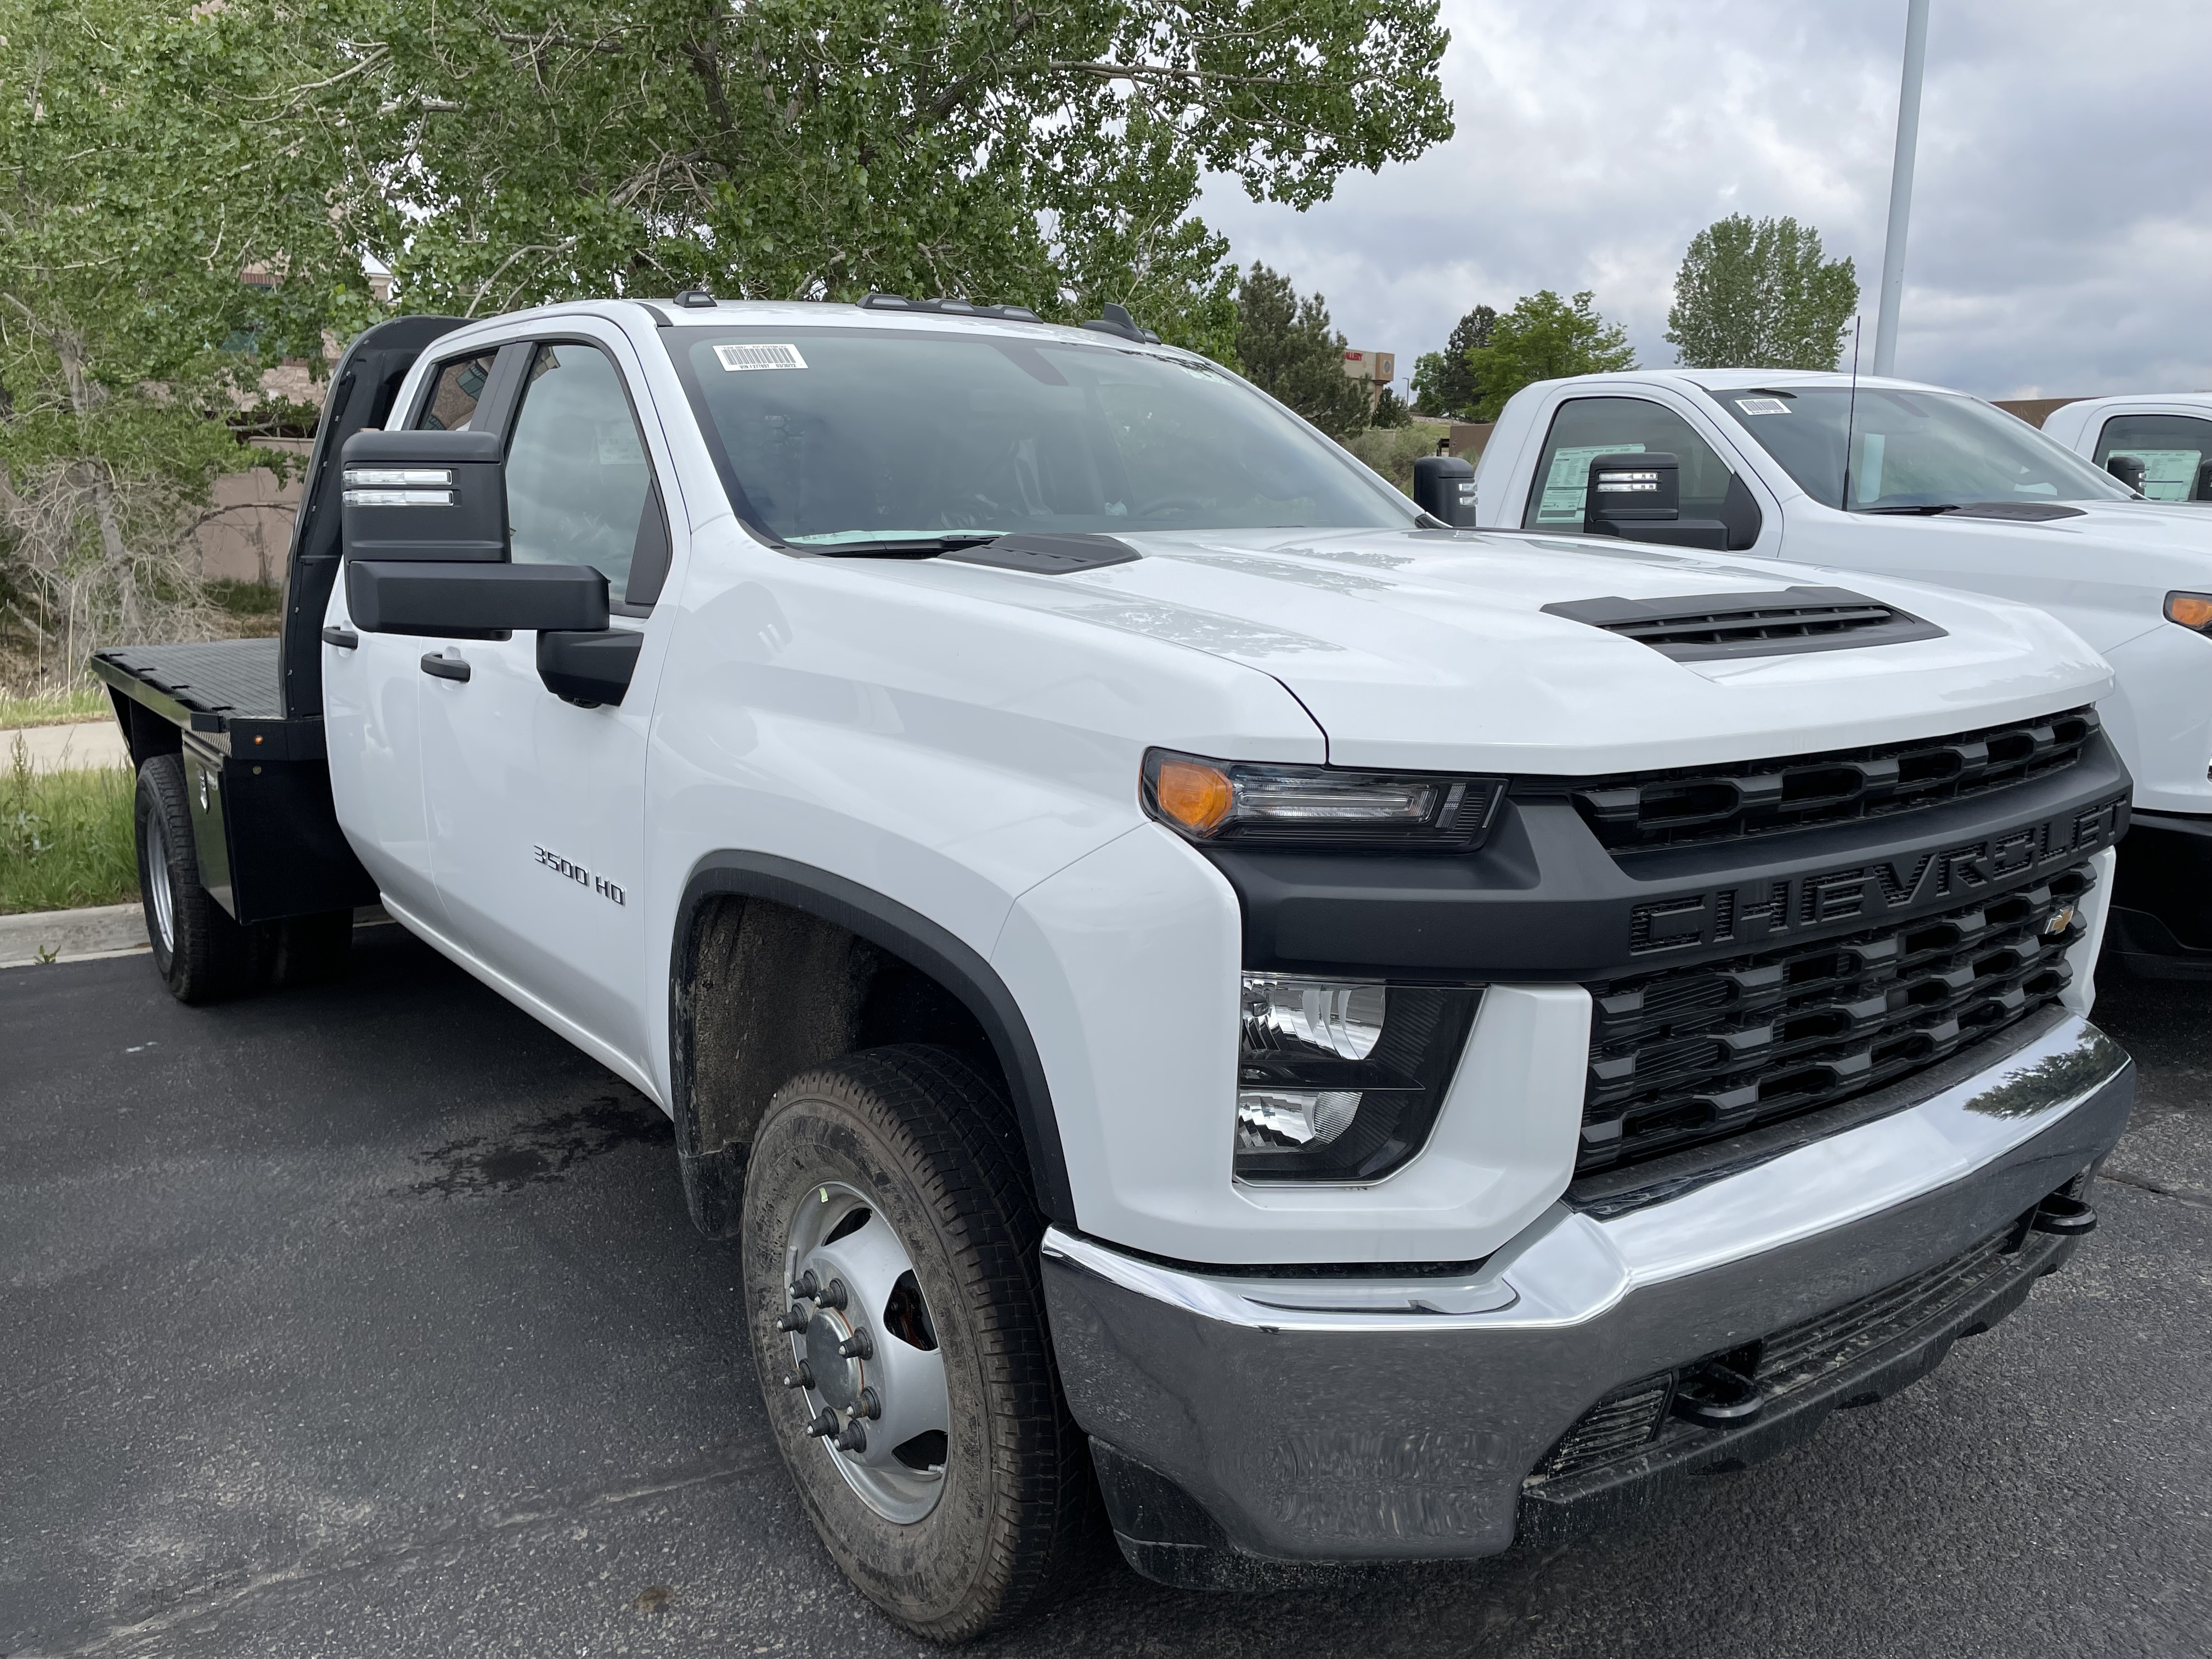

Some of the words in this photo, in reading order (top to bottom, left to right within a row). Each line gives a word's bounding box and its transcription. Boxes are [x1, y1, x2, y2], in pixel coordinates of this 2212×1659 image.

[534, 844, 590, 887] 3500
[595, 873, 626, 906] HD
[1629, 793, 2126, 955] CHEVROLET
